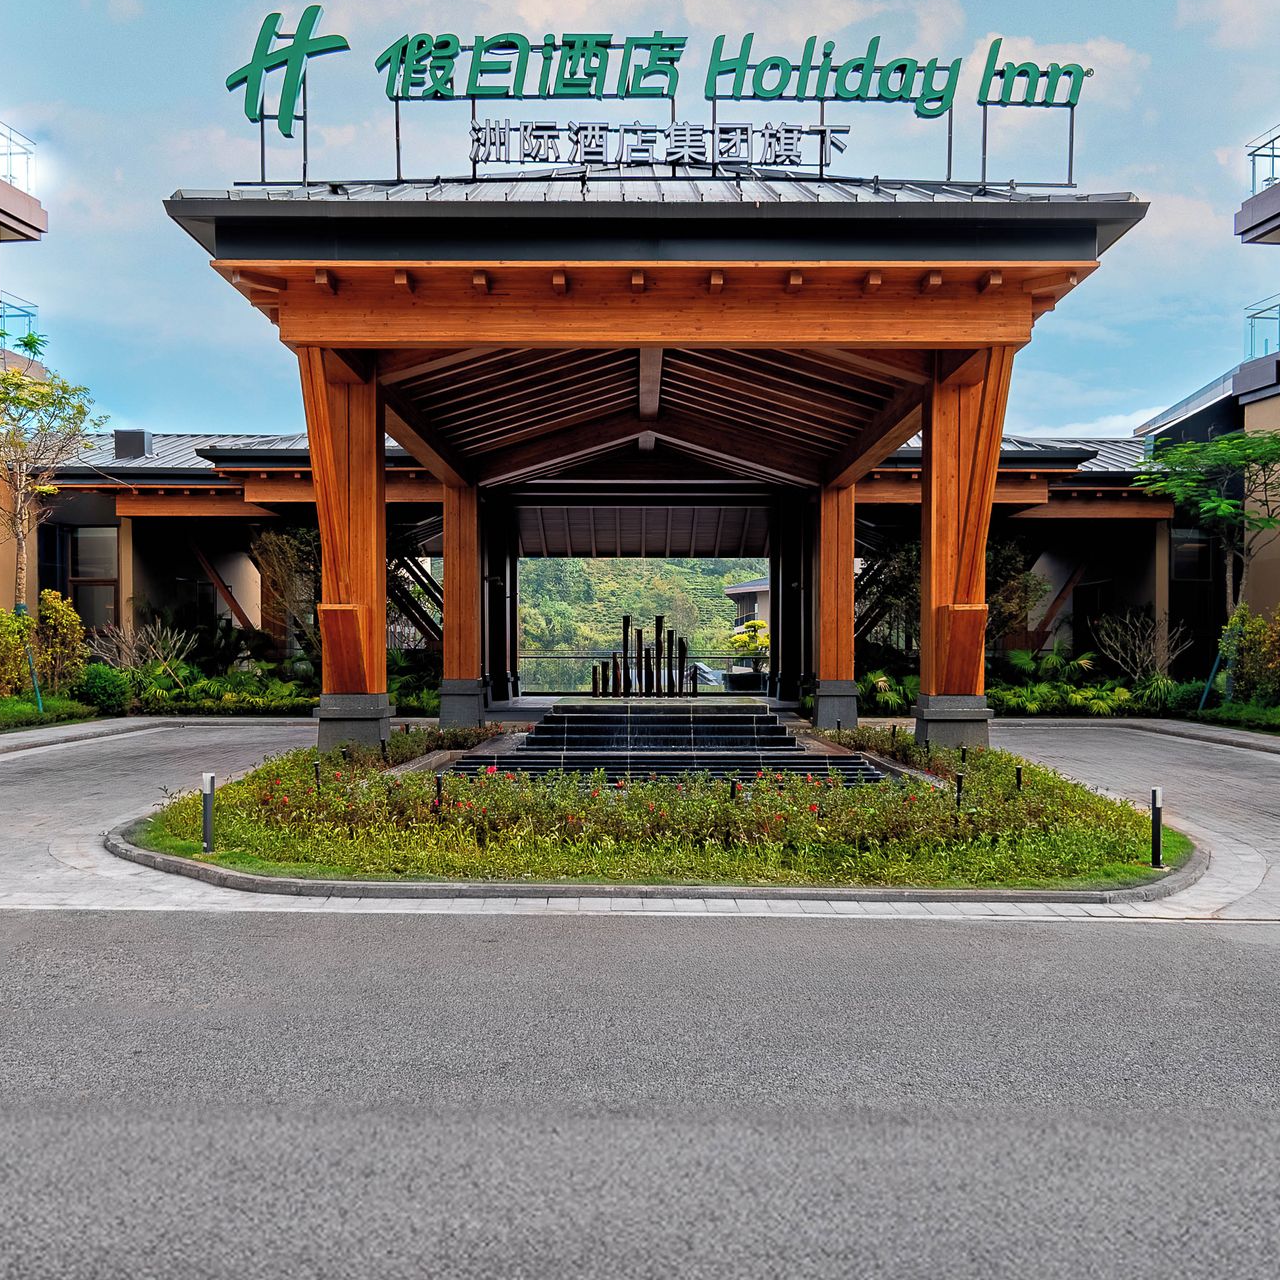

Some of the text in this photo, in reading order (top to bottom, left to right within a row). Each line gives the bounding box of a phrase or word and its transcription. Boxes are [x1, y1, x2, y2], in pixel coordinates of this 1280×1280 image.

[375, 30, 688, 101] 假日酒店
[704, 32, 962, 118] Holiday
[469, 118, 851, 166] 洲际酒店集团旗下
